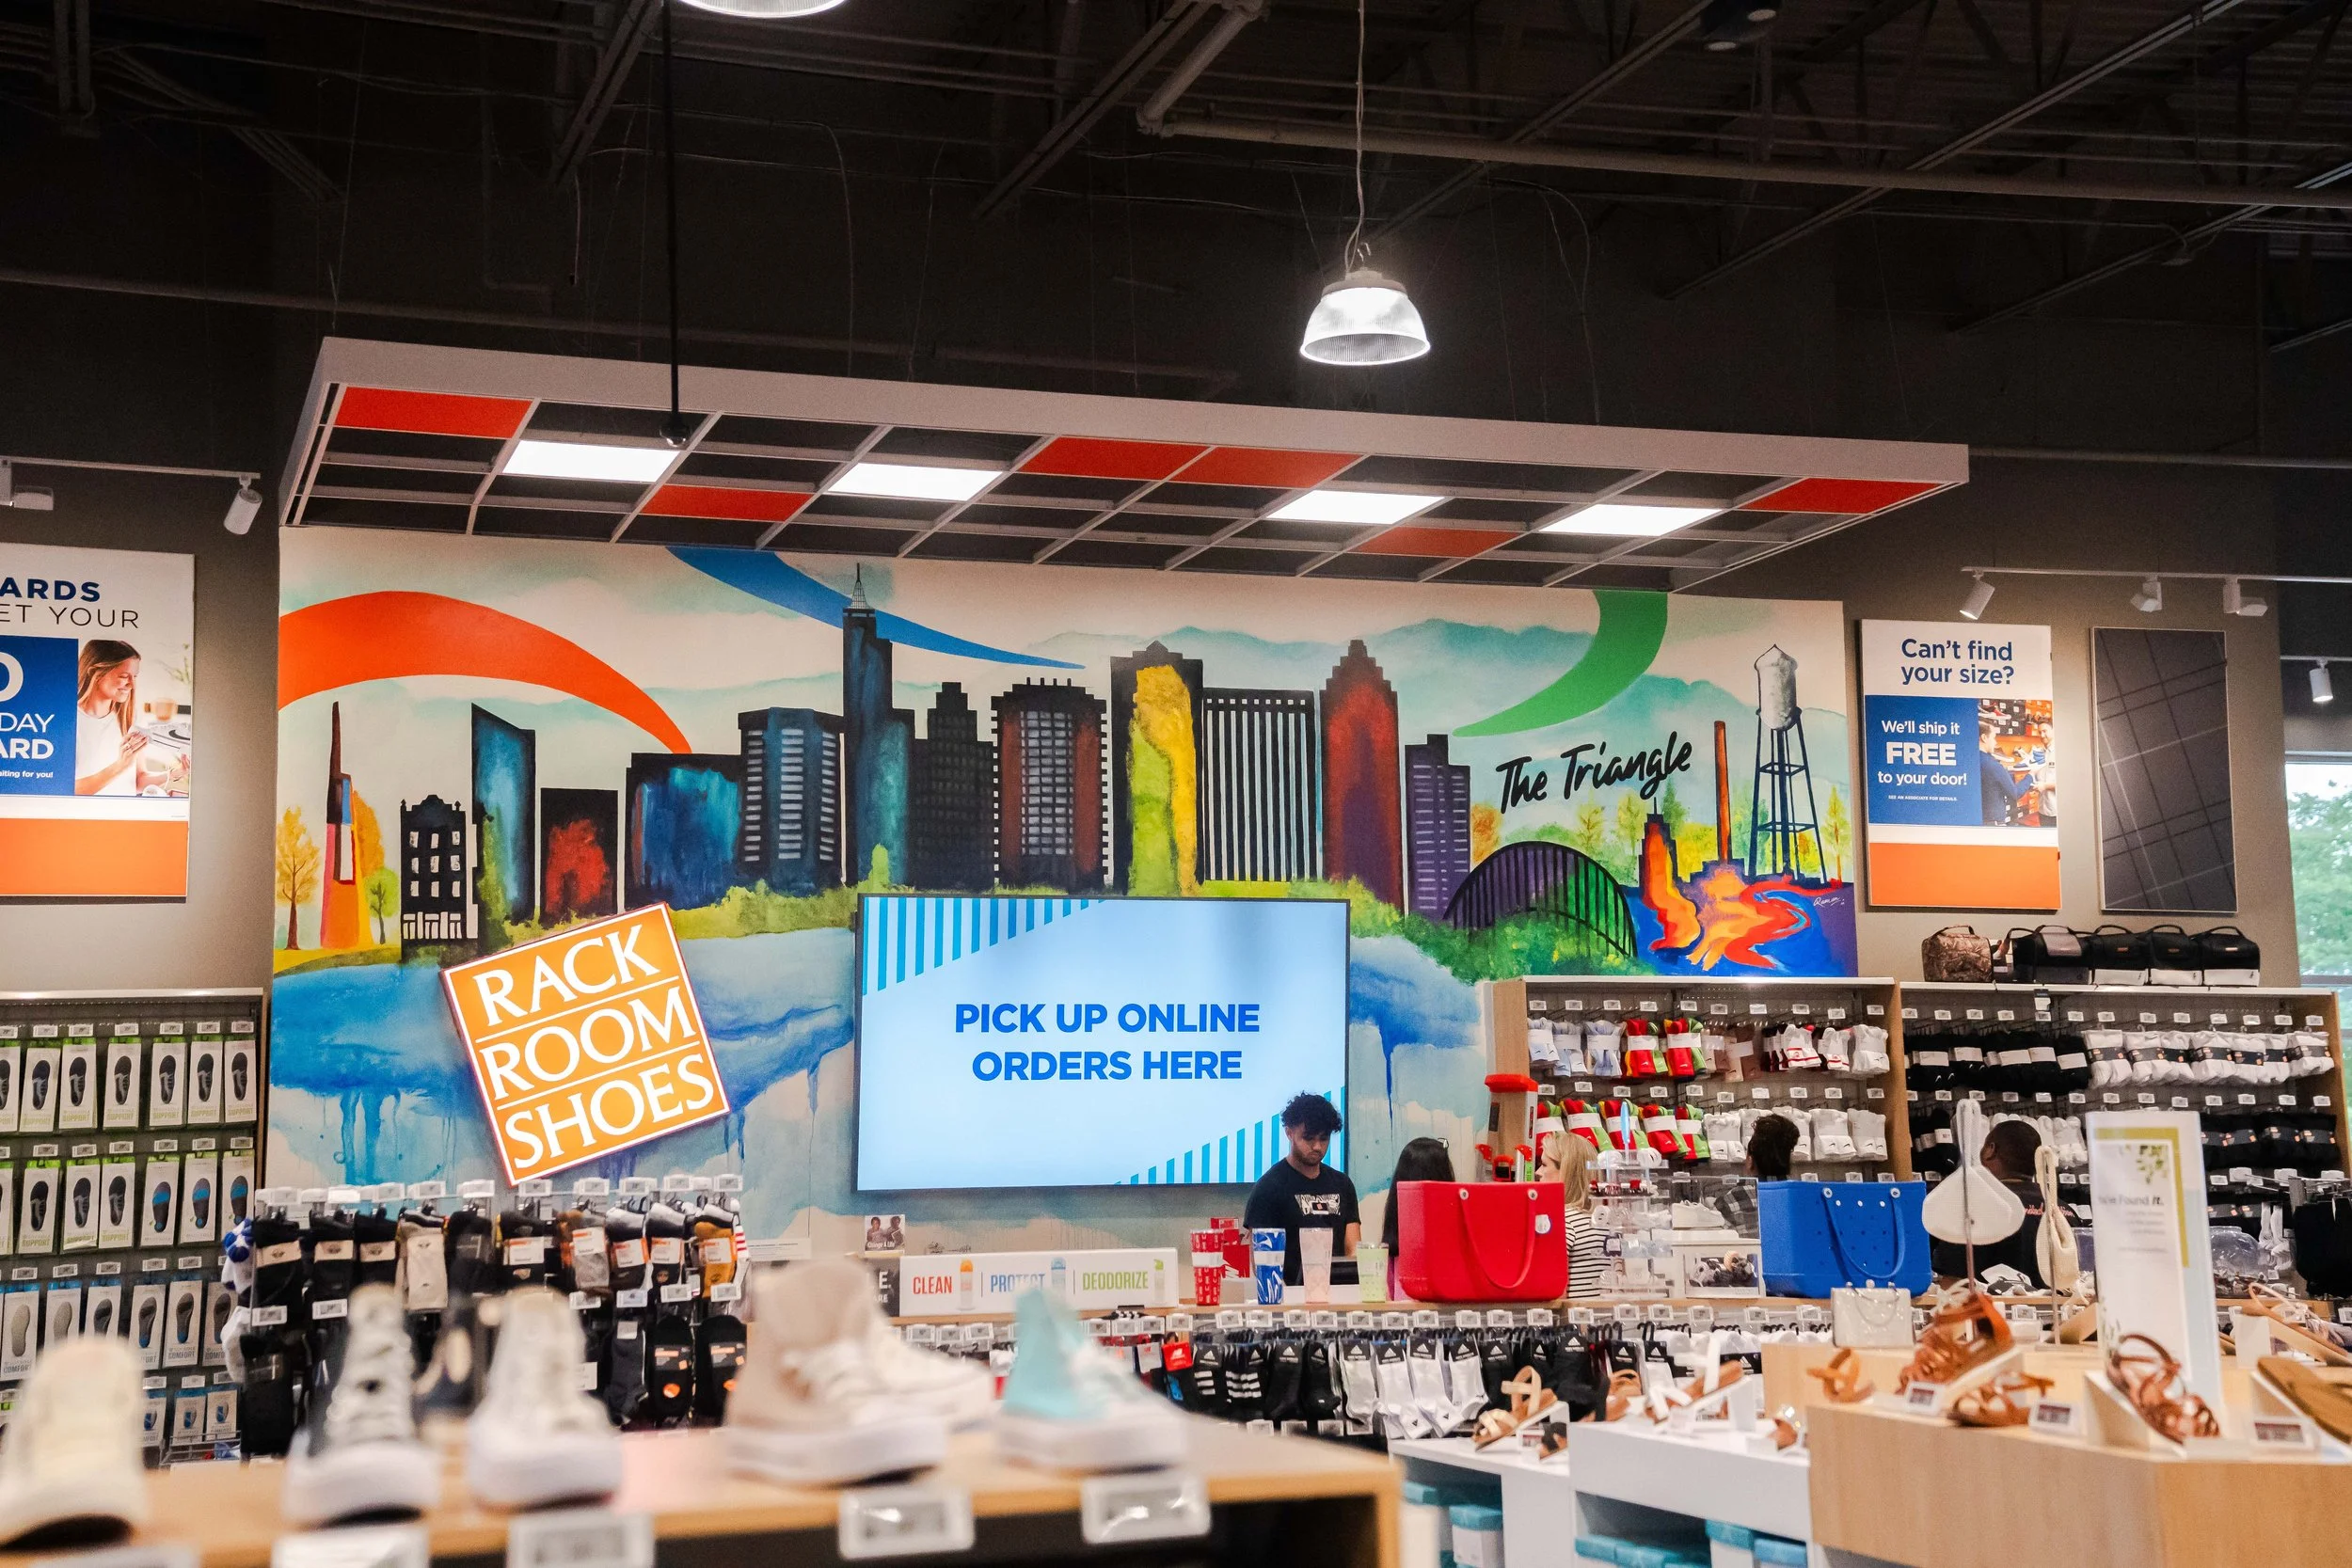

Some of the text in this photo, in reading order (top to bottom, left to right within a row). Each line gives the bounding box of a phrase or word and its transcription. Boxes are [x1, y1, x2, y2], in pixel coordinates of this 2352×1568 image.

[49, 606, 139, 629] YOUR
[1901, 639, 2012, 661] Can't find
[1901, 664, 2014, 686] your size?
[0, 712, 56, 733] DAY
[1882, 720, 1961, 736] We'll ship it
[1886, 741, 1957, 767] FREE
[23, 770, 35, 779] for
[37, 771, 54, 780] you!
[1495, 731, 1692, 815] The Triangle
[1878, 771, 1967, 786] to your door!
[472, 924, 660, 1027] RACK
[955, 1003, 1261, 1034] PICK UP ONLINE
[480, 986, 696, 1101] ROOM
[972, 1050, 1243, 1082] ORDERS HERE
[504, 1053, 714, 1169] SHOES
[913, 1275, 953, 1295] CLEAN
[991, 1274, 1045, 1292] PROTECT
[1082, 1271, 1149, 1291] DEODORIZE
